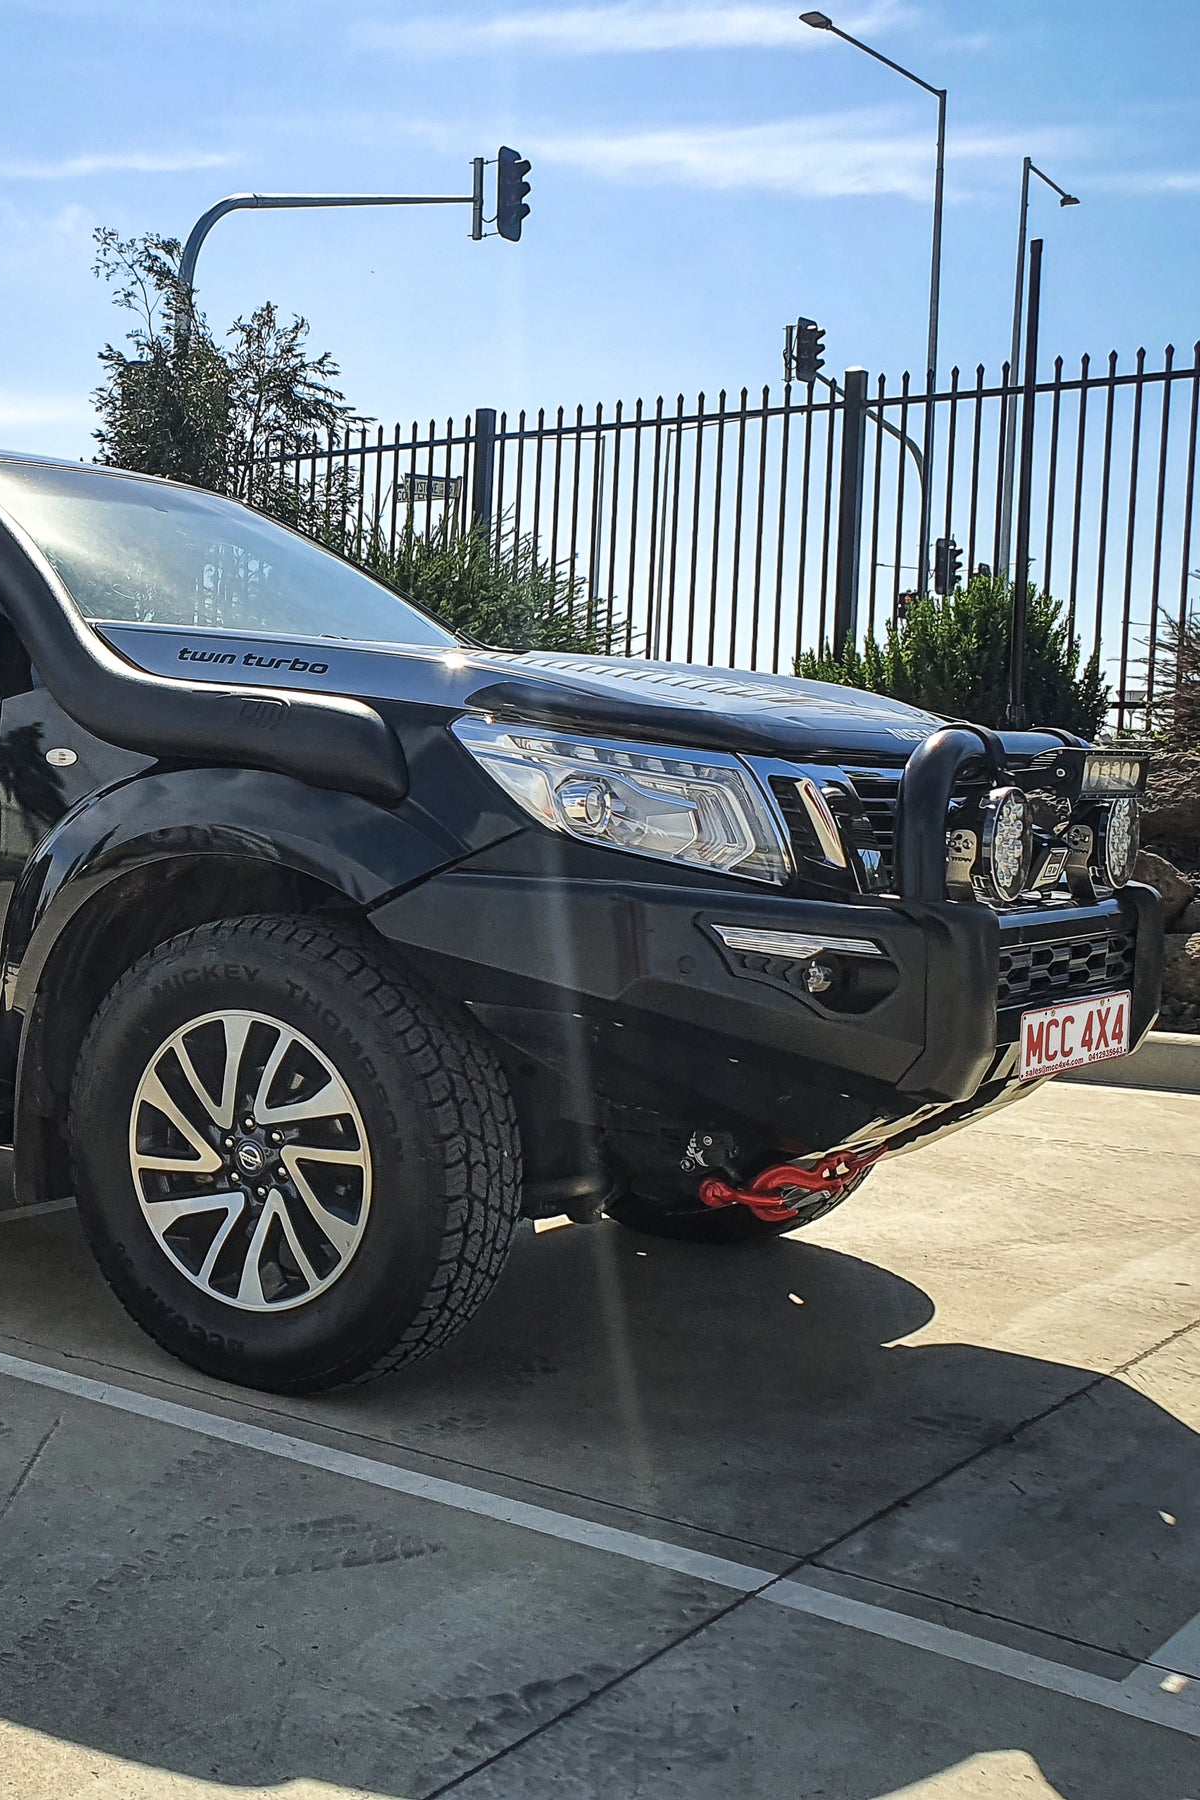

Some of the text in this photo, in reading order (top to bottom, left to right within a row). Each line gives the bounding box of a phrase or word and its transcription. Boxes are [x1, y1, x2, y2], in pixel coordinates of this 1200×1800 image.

[178, 647, 329, 675] twin turbo
[150, 963, 260, 993] MICKEY
[1025, 1004, 1124, 1067] MCC 4X4
